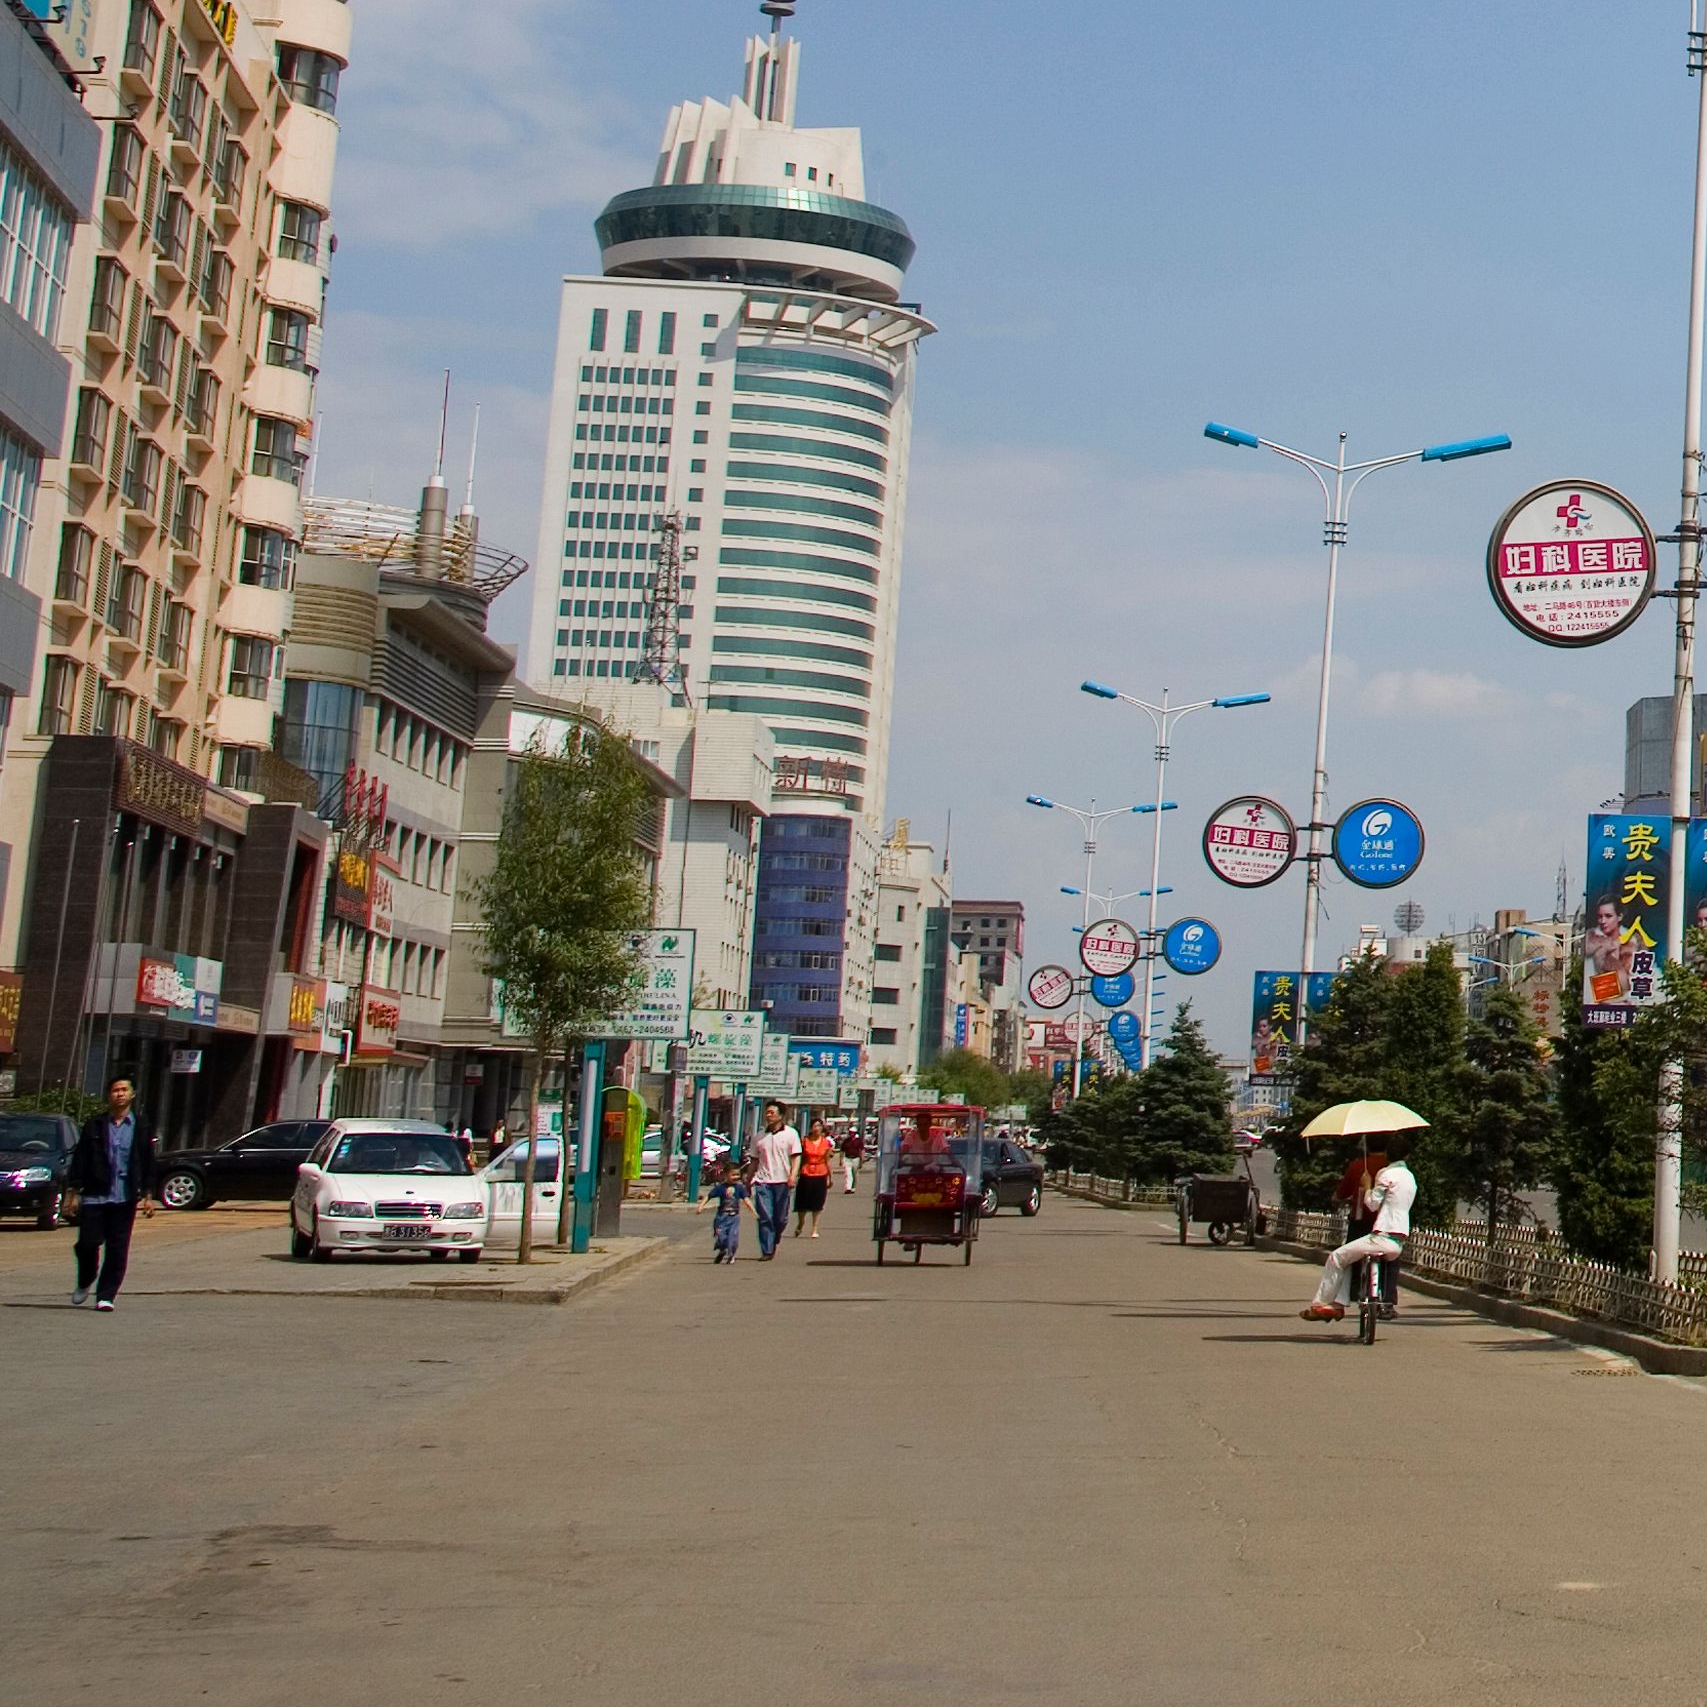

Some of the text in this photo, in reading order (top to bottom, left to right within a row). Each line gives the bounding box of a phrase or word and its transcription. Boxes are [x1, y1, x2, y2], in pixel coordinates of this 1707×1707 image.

[1506, 542, 1642, 574] 妇科医院
[1213, 825, 1289, 851] 妇科医院
[1619, 822, 1660, 948] 贵夫人
[1631, 950, 1655, 1002] 皮草
[1269, 976, 1293, 1043] 贵夫人
